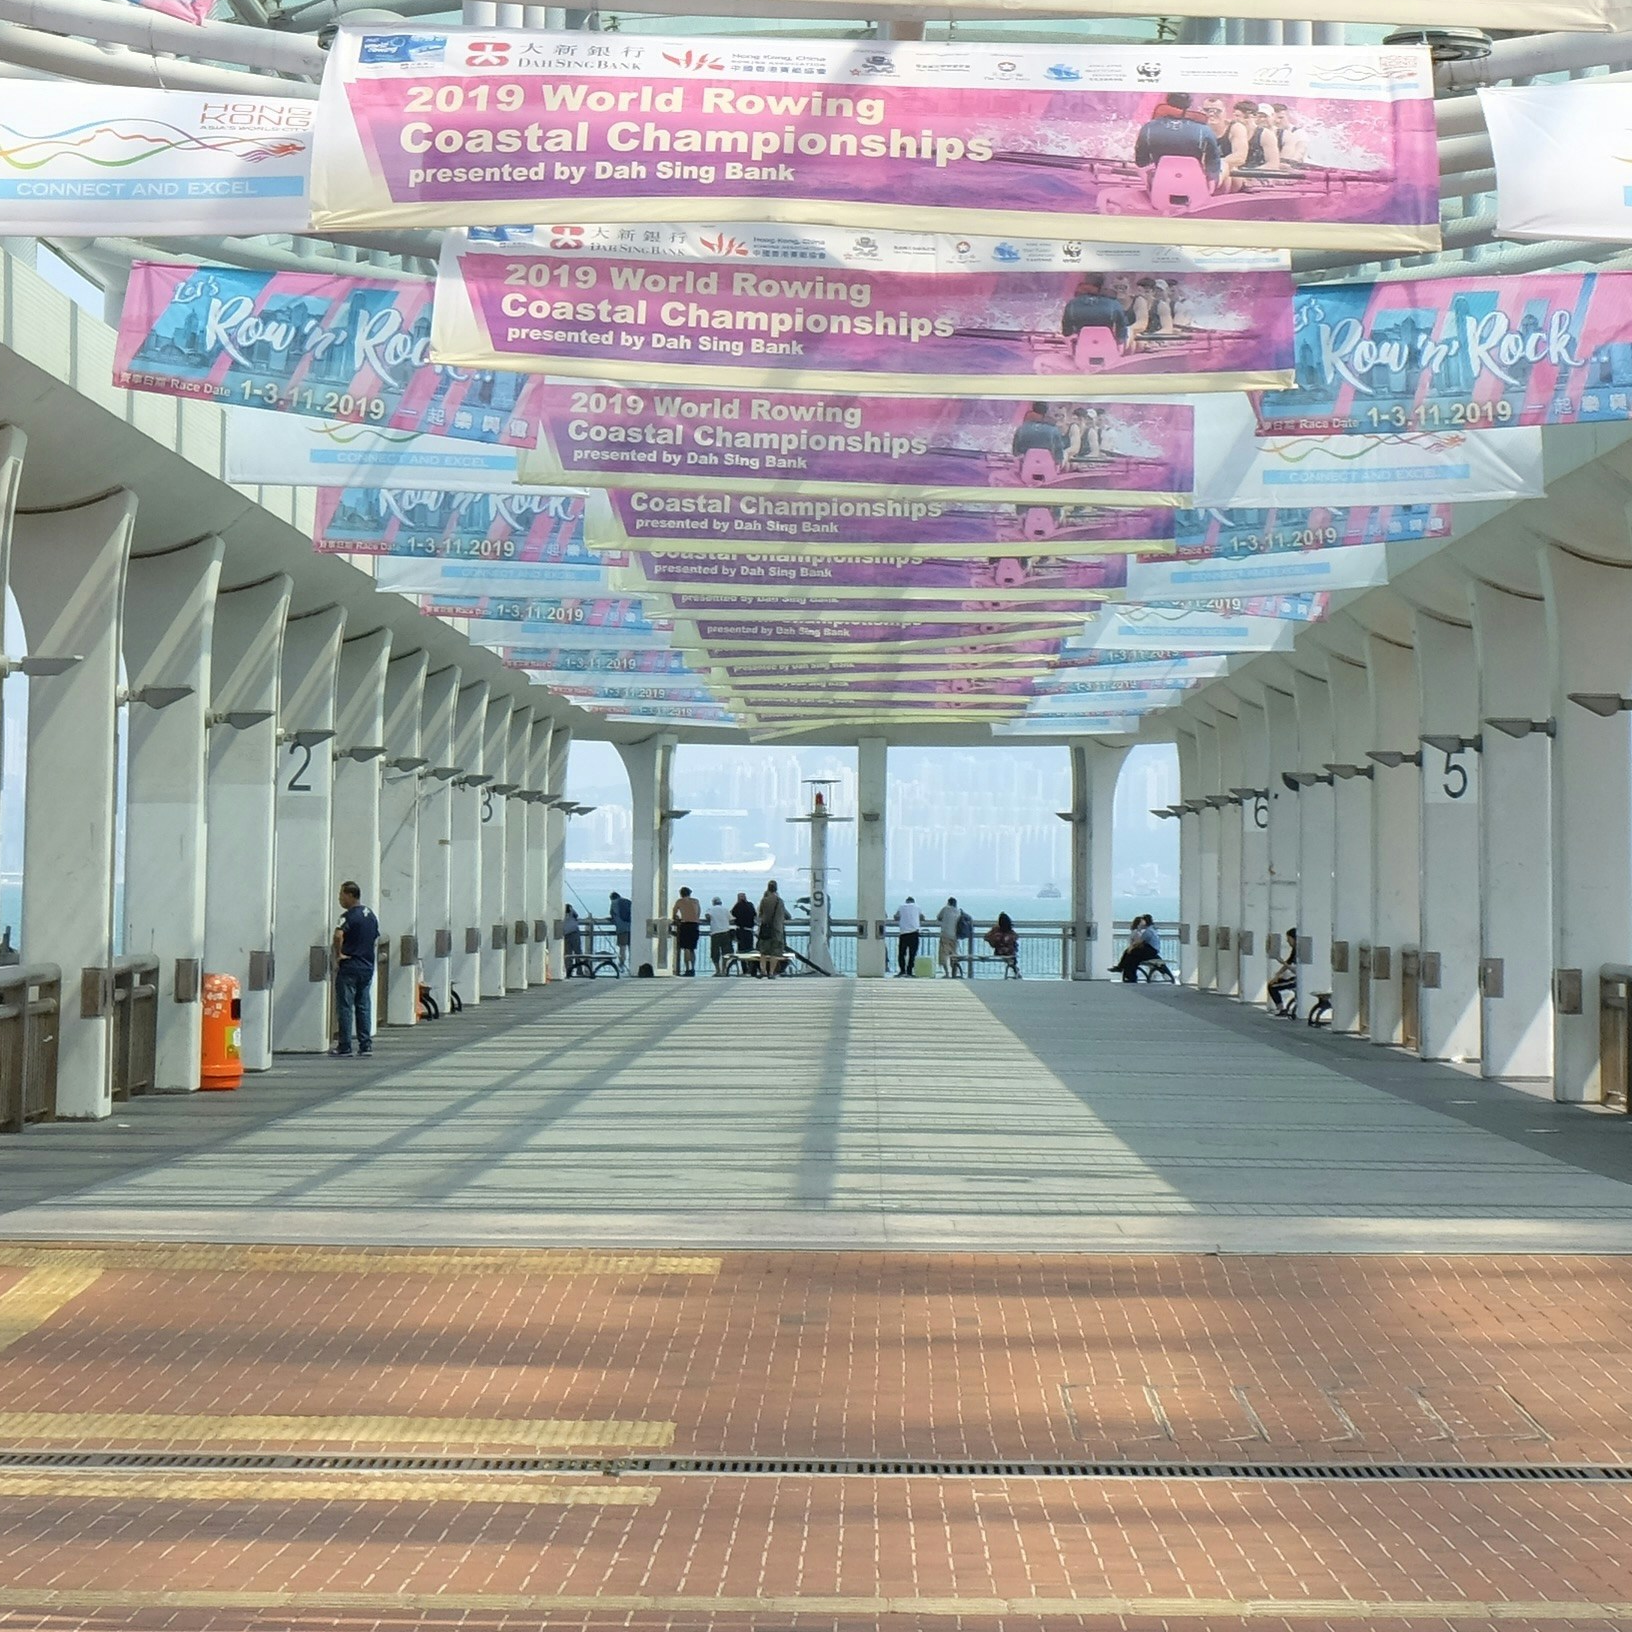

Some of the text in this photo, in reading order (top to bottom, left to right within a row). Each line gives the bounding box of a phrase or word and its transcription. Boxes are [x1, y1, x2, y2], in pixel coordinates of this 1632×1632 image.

[519, 42, 646, 59] 大新銀行
[200, 112, 311, 126] KONG
[203, 102, 312, 116] HONG
[403, 84, 885, 125] 2019 World Rowing
[400, 121, 994, 168] Coastal Championships
[17, 181, 257, 197] CONNECT AND EXCEL
[408, 161, 795, 188] presented by Dah Sing Bank
[592, 226, 689, 244] 大新銀行
[503, 263, 871, 308] 2019 World Rowing
[205, 294, 295, 367] Row
[501, 292, 955, 344] Coastal Championships
[507, 325, 804, 356] presented by Dah Sing Bank
[1320, 310, 1585, 394] Row Rock
[171, 378, 385, 421] Race Date 1-3.11.2019
[569, 392, 862, 429] 2019 World Rowing
[1368, 399, 1511, 429] 1-3.11.2019
[568, 419, 929, 459] Coastal Championships
[573, 447, 808, 469] presented by Dah Sing Bank
[630, 491, 943, 521] Coastal Championships
[635, 518, 839, 534] presented by Dah Sing Bank
[1231, 527, 1338, 552] 1-3.11.2019
[406, 537, 515, 557] 1-3.11.2019
[654, 564, 833, 579] presented by Dah Sing Bank
[497, 604, 583, 621] 1-3.11.2019
[288, 742, 312, 791] 2
[1442, 752, 1468, 798] 5
[481, 788, 492, 823] 3
[1254, 795, 1268, 828] 6
